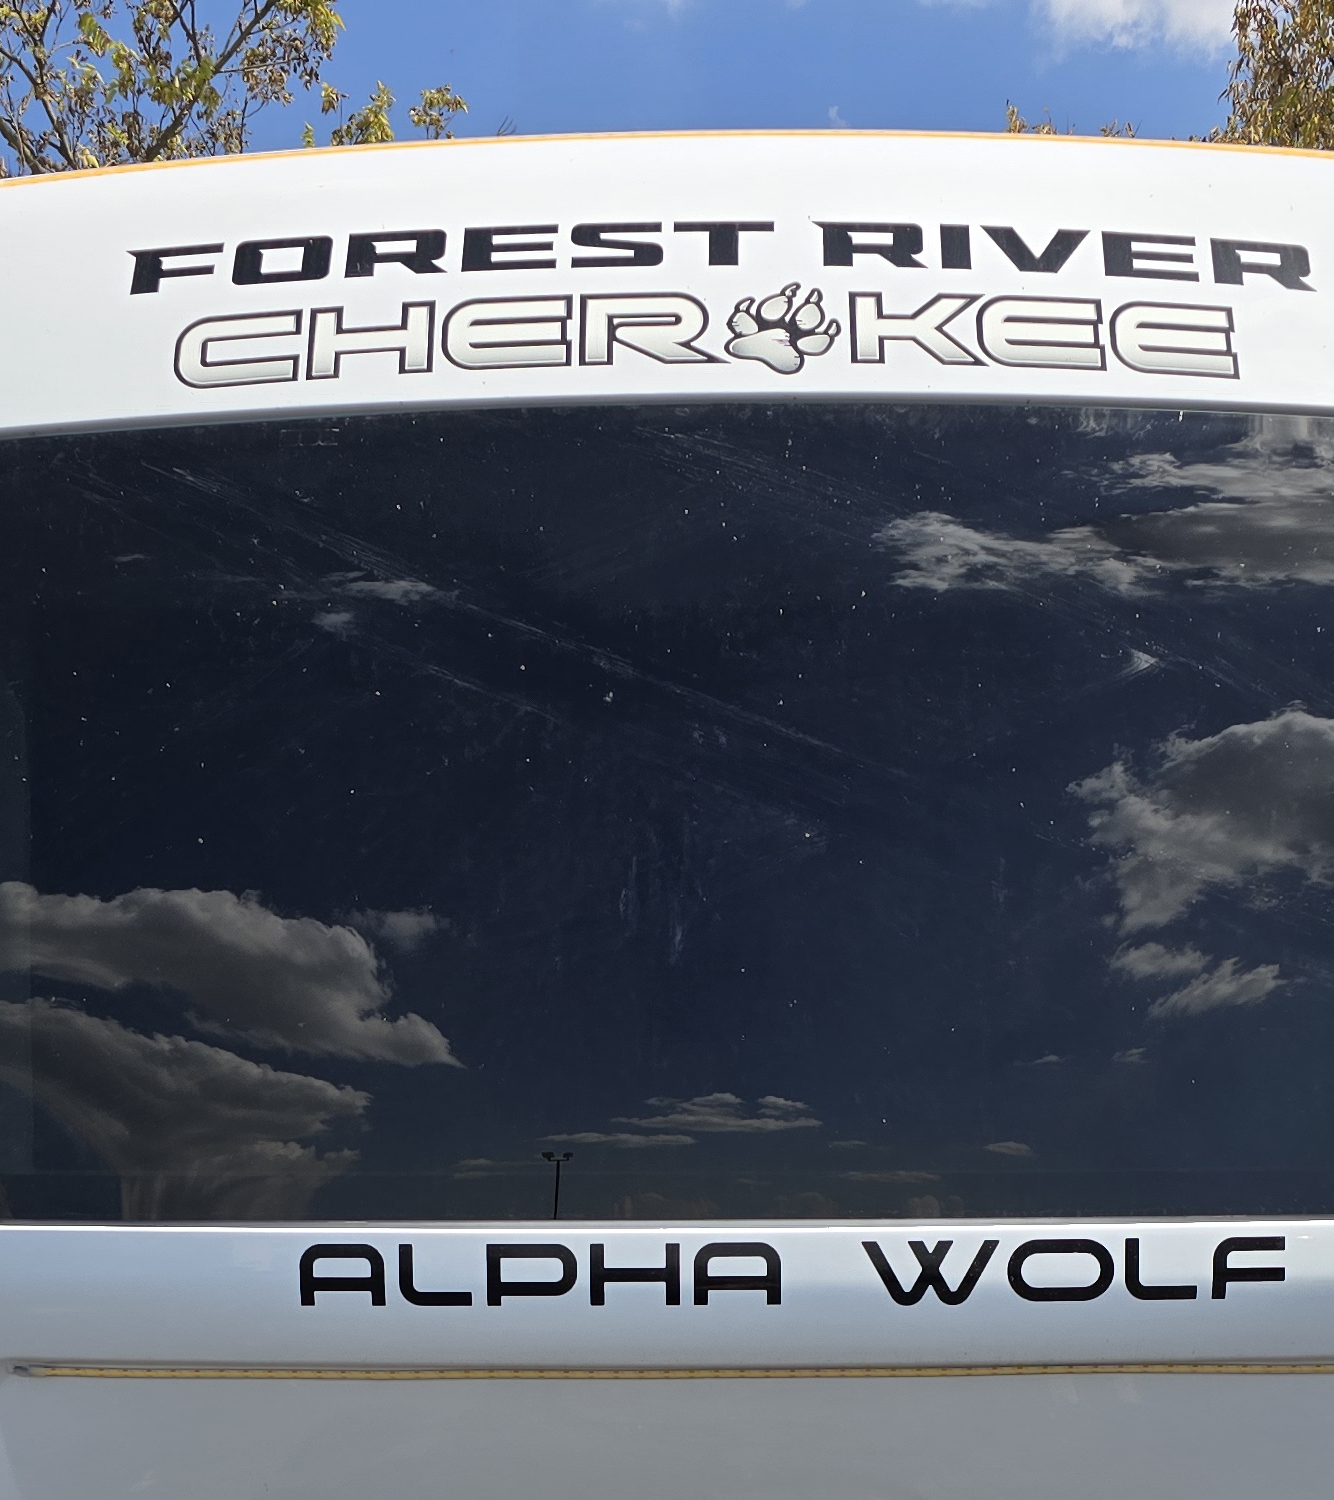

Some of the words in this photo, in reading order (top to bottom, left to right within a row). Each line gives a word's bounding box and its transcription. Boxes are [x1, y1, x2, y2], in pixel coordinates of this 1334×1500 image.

[127, 221, 774, 295] FOREST
[812, 221, 1317, 292] RIVER
[173, 283, 1240, 388] CHERKEE
[299, 1242, 782, 1307] ALPHA
[861, 1236, 1287, 1306] WOLF
